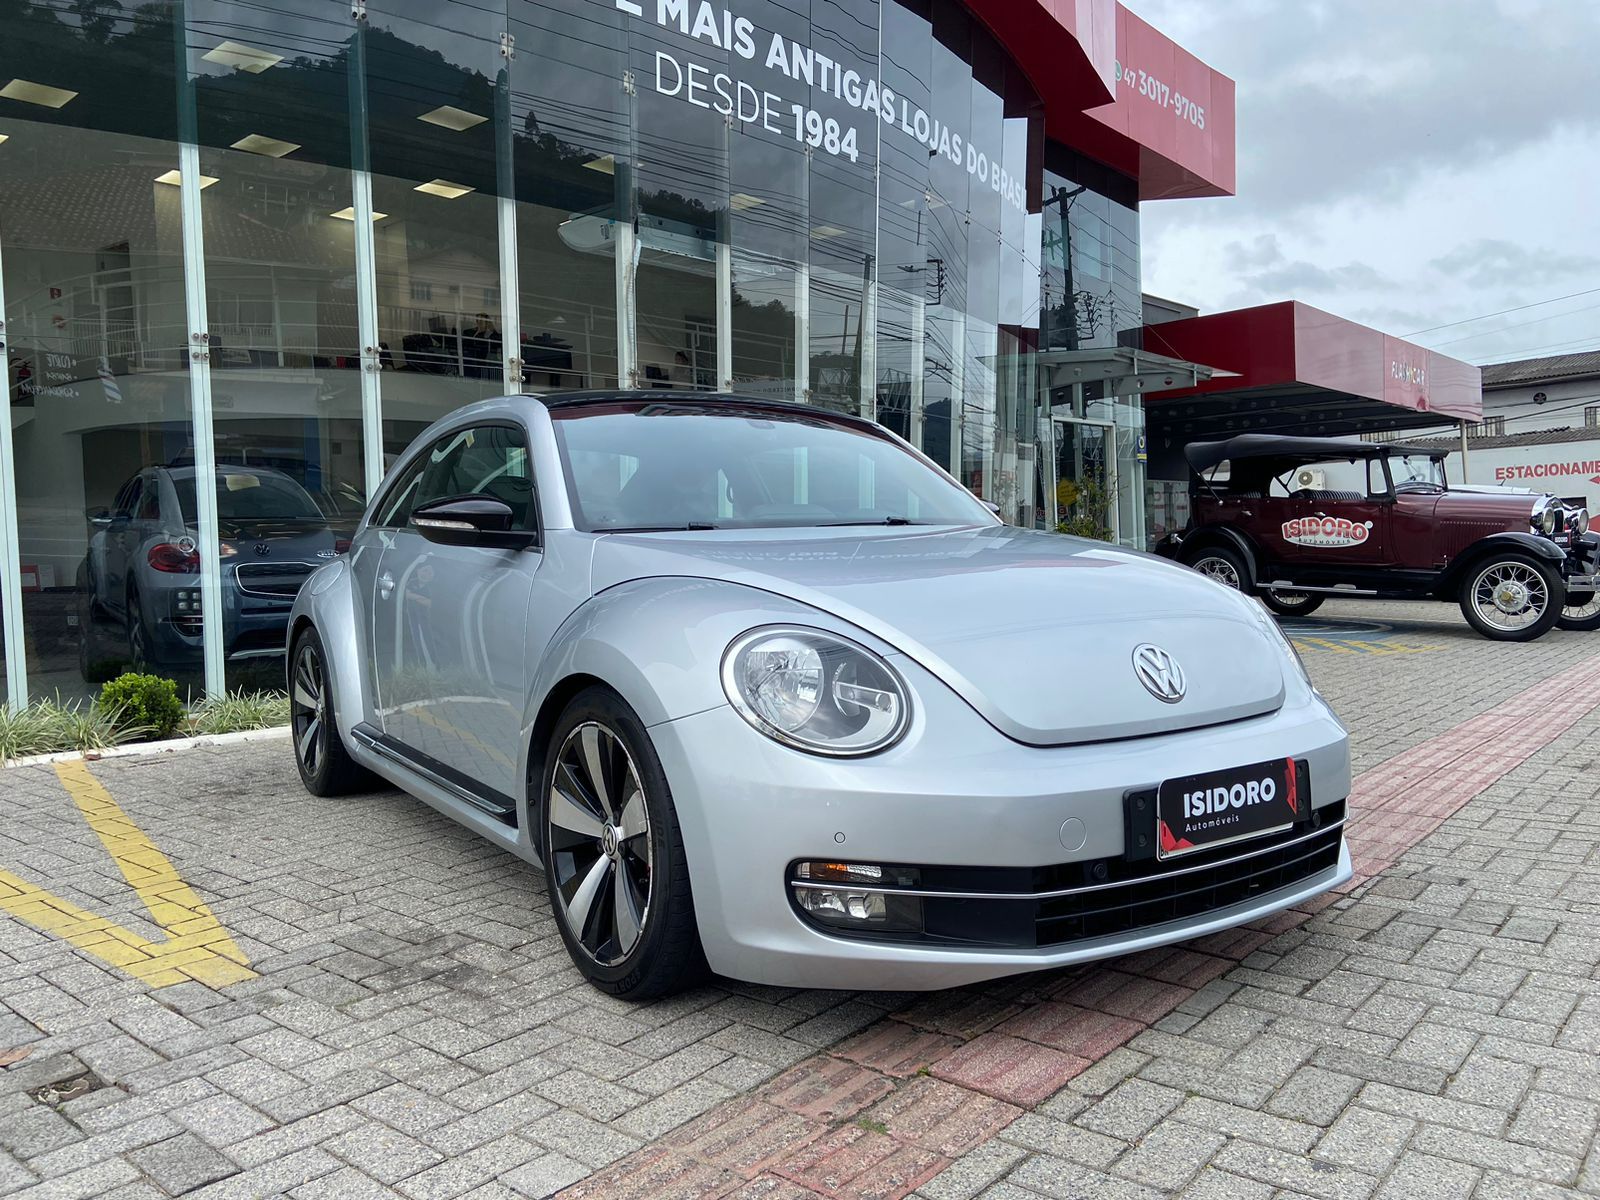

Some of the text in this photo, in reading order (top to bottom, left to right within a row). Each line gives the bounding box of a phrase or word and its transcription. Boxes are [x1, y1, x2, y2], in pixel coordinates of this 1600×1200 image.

[655, 50, 859, 163] DESDE 1984
[657, 0, 1026, 213] MAIS ANTIGAS LOJAS DO BRASI
[1124, 68, 1205, 130] 47 3017-9705
[1495, 460, 1600, 480] ESTACIONAME
[1283, 517, 1369, 541] ISIDORO
[1183, 776, 1276, 818] ISIDORO
[1185, 813, 1240, 833] Automóveis
